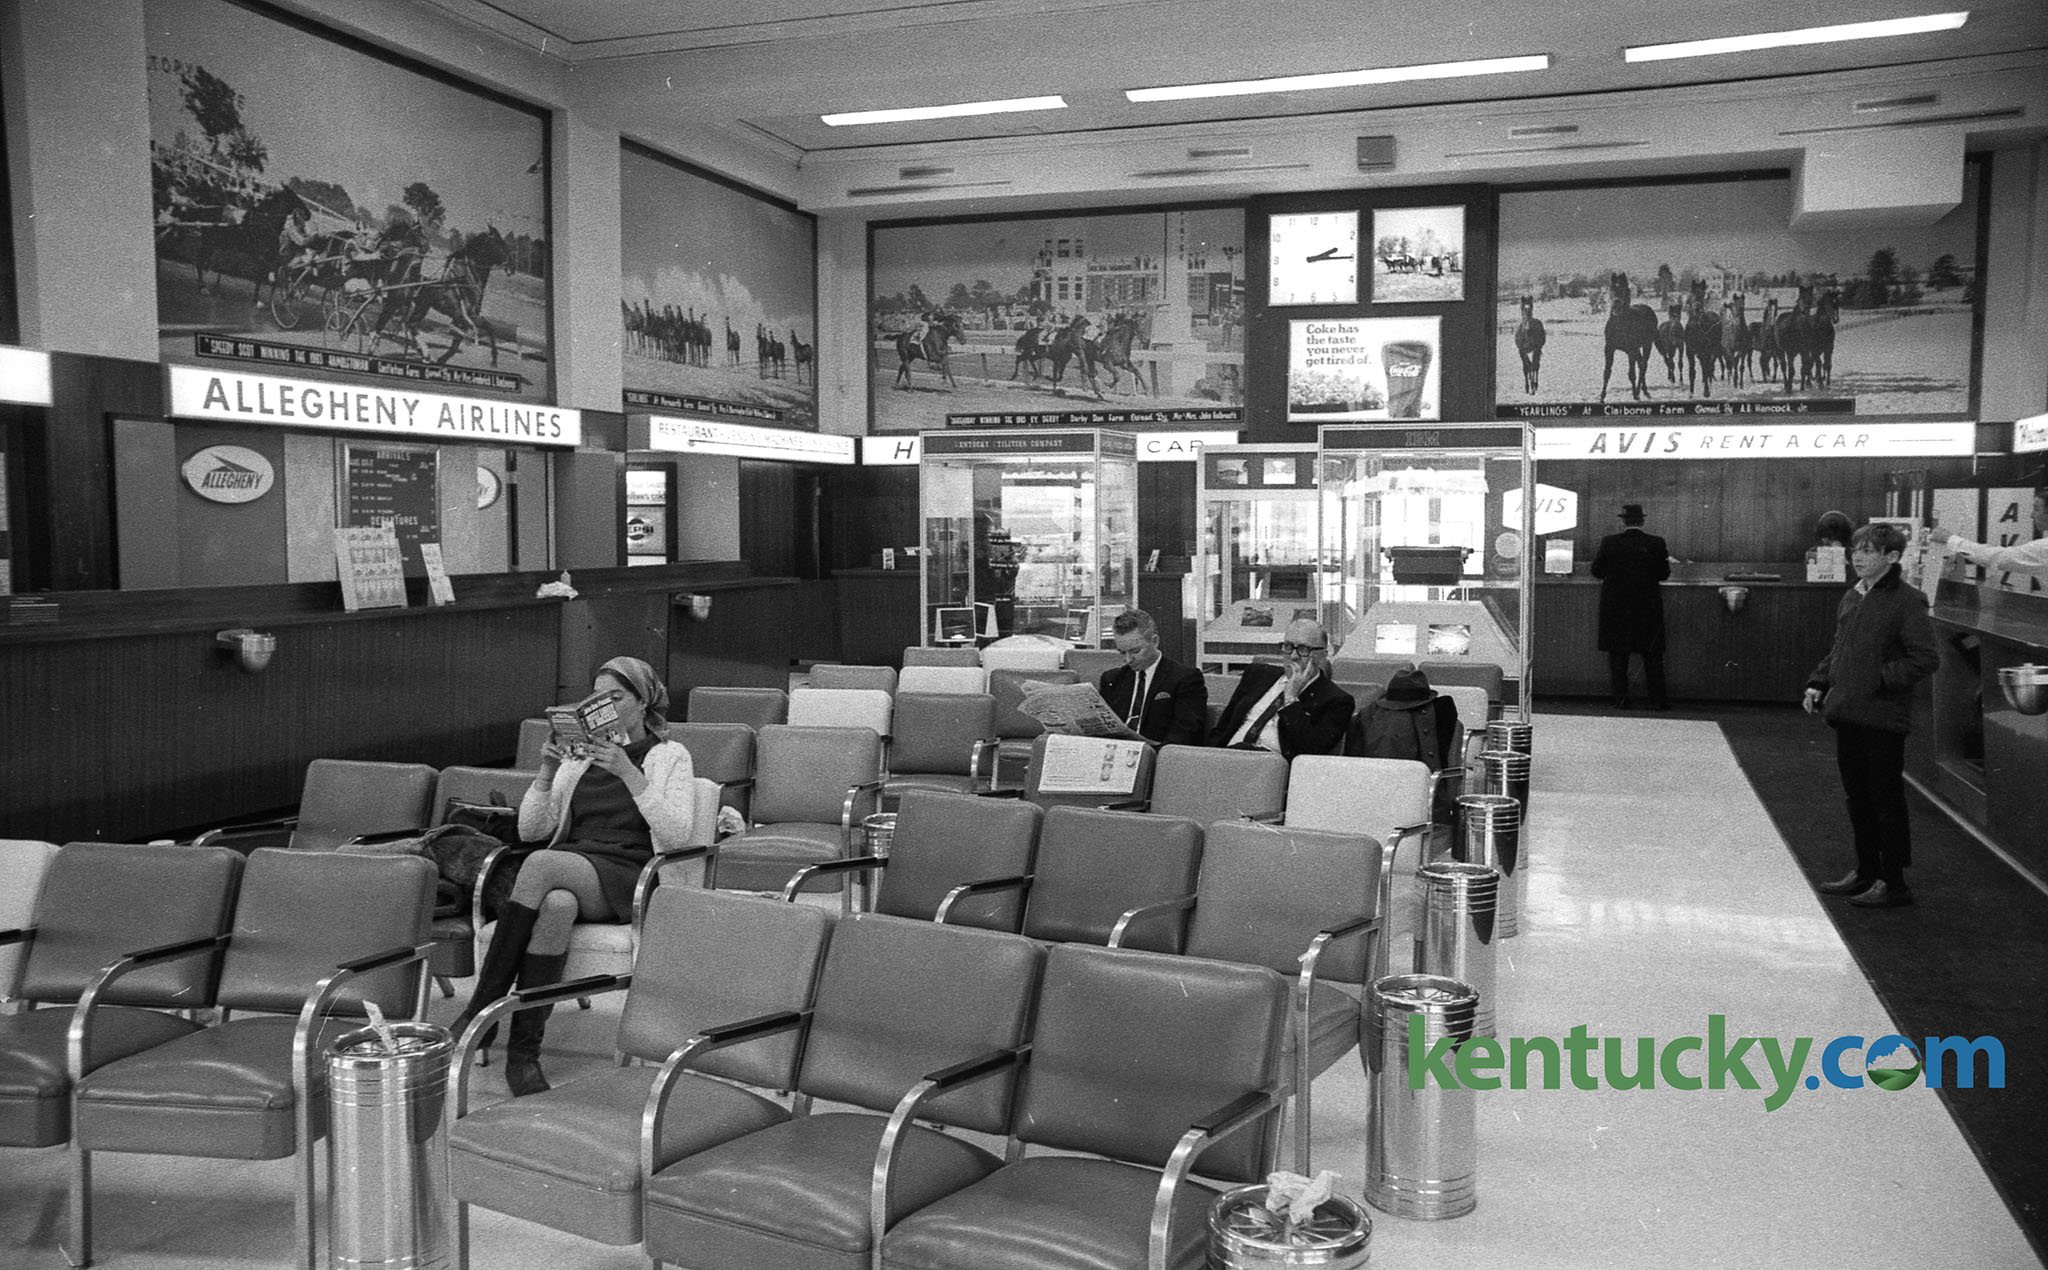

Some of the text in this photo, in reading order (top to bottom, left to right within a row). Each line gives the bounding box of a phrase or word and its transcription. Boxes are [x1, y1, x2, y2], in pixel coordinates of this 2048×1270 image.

[1310, 216, 1319, 226] 12
[1273, 233, 1281, 243] 10
[1348, 275, 1355, 284] 4
[1306, 323, 1360, 335] Coke has
[1306, 335, 1357, 345] the taste
[1306, 346, 1366, 357] you never
[1305, 354, 1373, 367] get tired of.
[202, 377, 562, 438] ALLEGHENY AIRLINES
[1582, 406, 1592, 416] At
[1604, 405, 1652, 415] Claiborne
[1659, 405, 1685, 414] Farm
[1694, 404, 1720, 414] Owned
[659, 422, 718, 439] RESTAURANT
[956, 439, 1063, 449] ENTUCKY TILITIES COMPANY
[1405, 430, 1440, 447] IBM
[1588, 431, 1870, 454] AVIS RENT A CAR
[201, 471, 264, 489] ALLEGHENY
